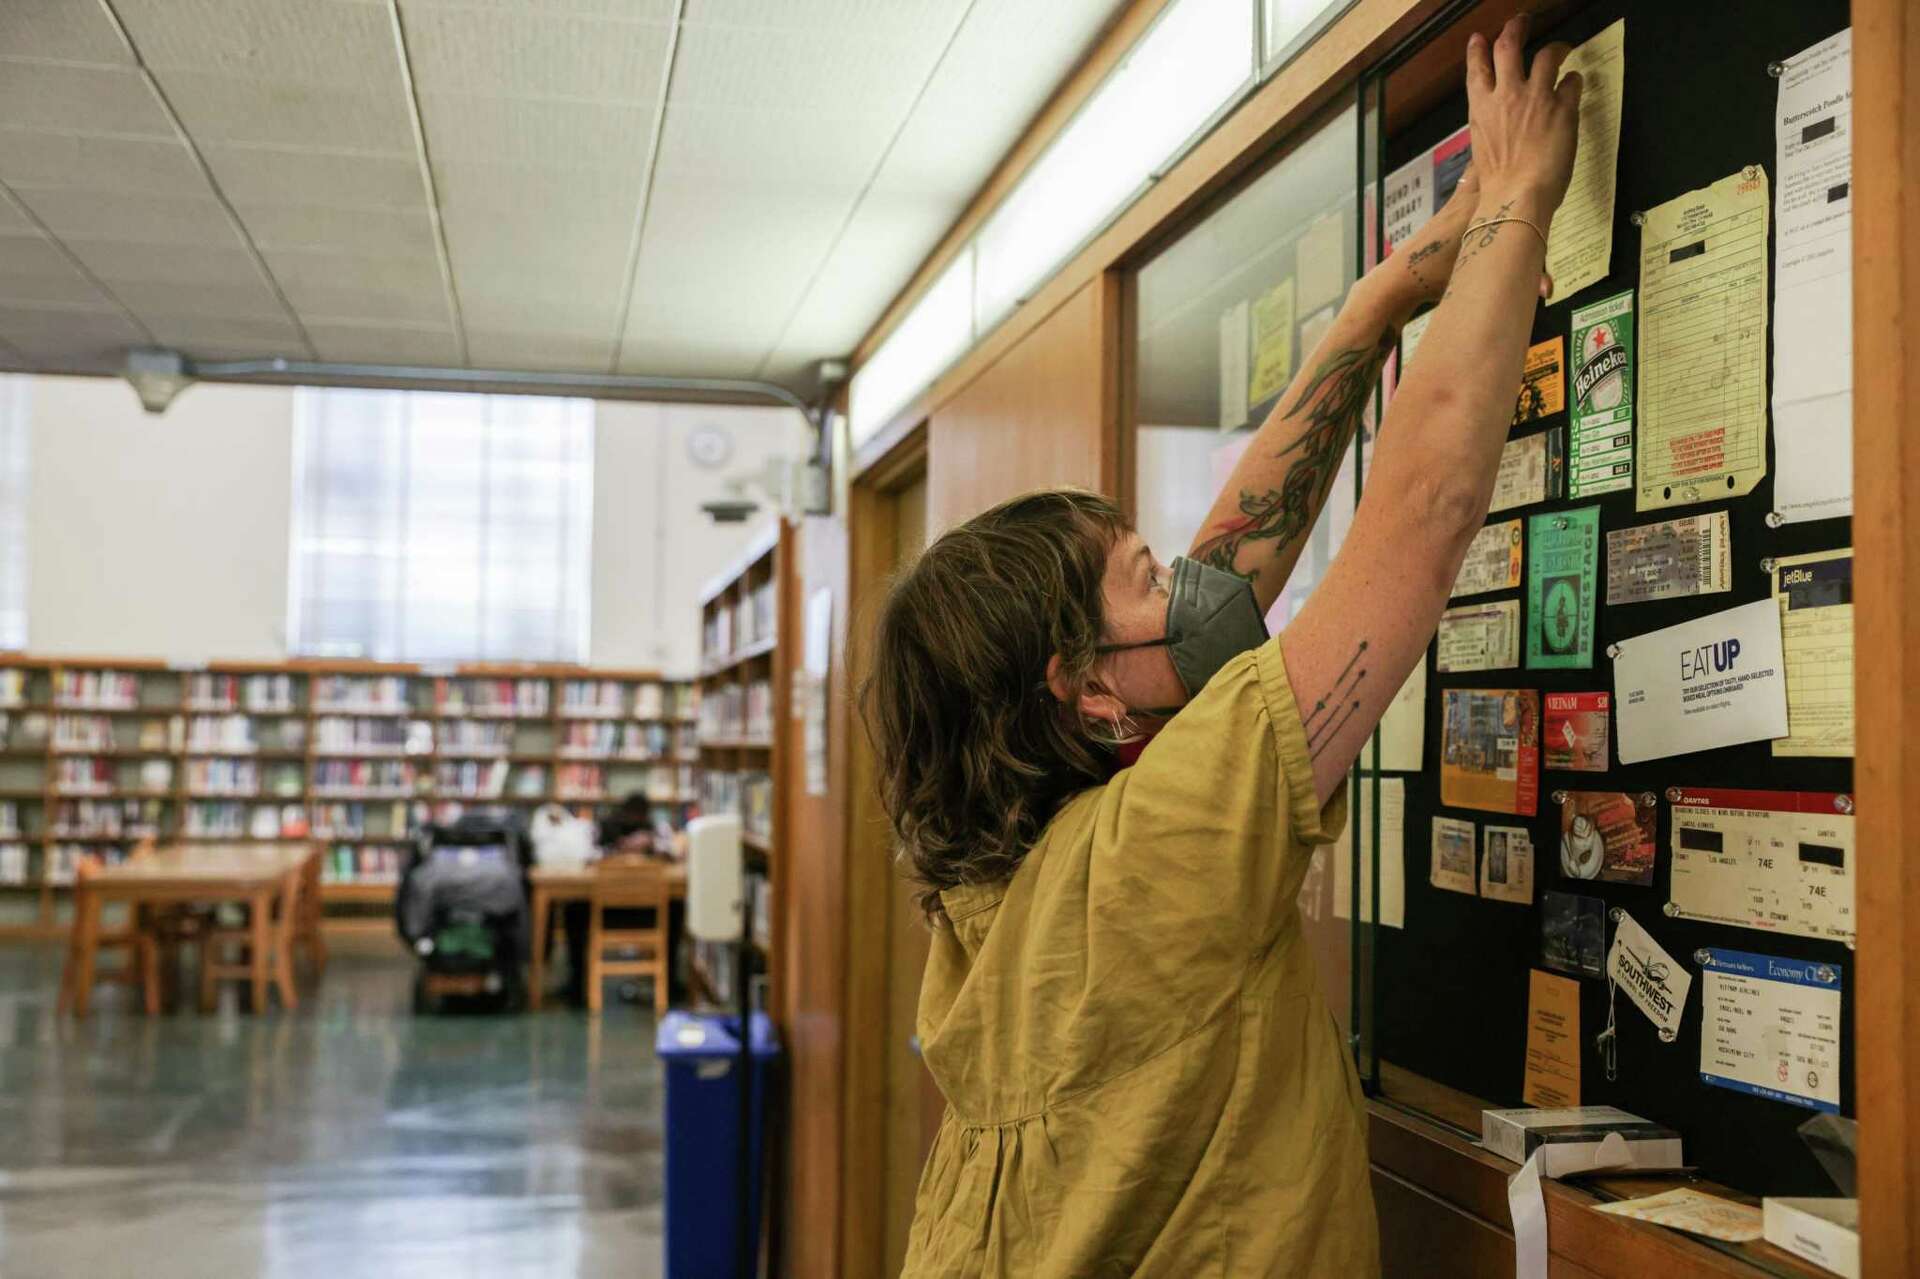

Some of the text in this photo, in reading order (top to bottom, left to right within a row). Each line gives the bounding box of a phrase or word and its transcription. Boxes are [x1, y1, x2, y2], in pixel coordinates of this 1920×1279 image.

[1387, 197, 1422, 226] LIBRARY
[1578, 523, 1594, 653] BACKSTAGE
[1783, 569, 1813, 588] jetBlue
[1548, 697, 1577, 710] VIETNAM
[1683, 796, 1710, 805] QANTAS
[1757, 858, 1774, 870] 74E
[1808, 885, 1826, 897] 74E
[1769, 959, 1804, 980] Economy
[1618, 953, 1675, 1015] SOUTHWEST
